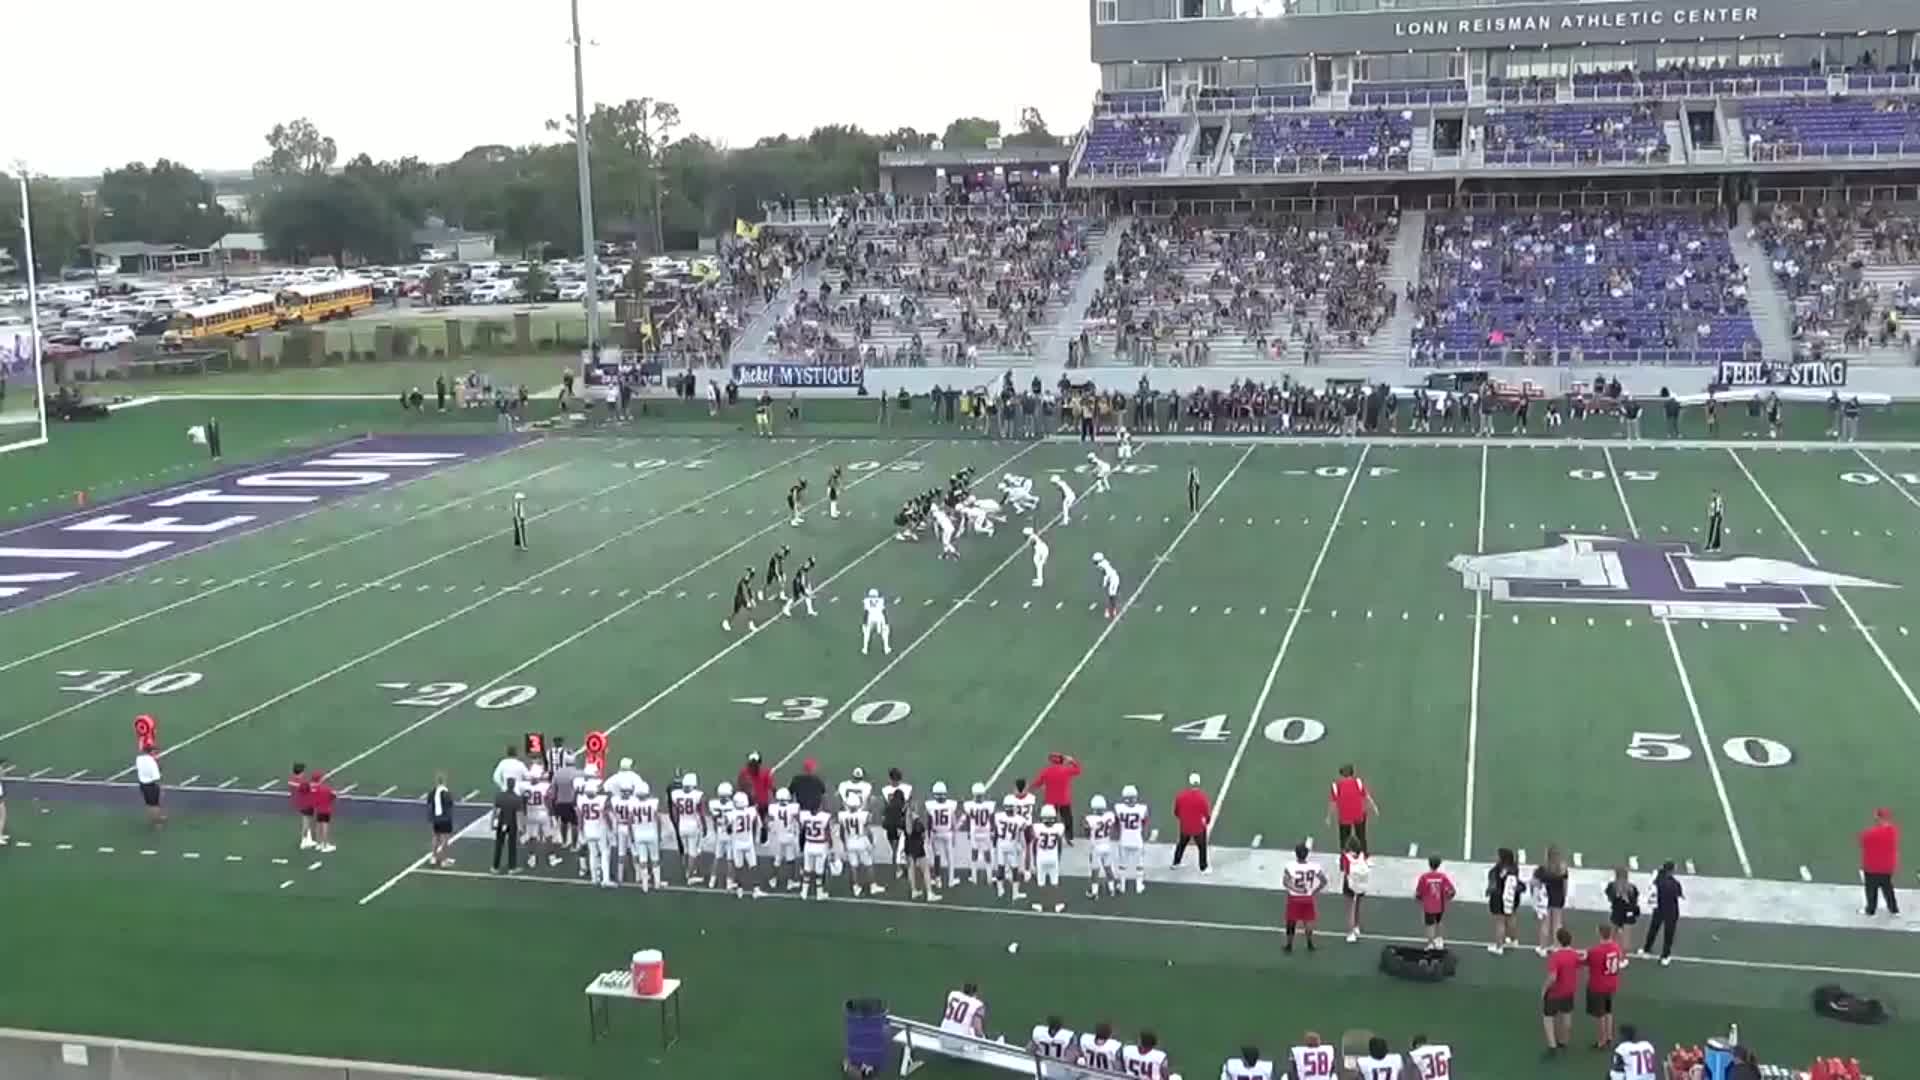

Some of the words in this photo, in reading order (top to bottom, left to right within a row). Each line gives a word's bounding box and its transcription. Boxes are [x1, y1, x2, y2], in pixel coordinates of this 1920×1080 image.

[1395, 22, 1448, 36] LONN
[1458, 17, 1550, 33] REISMAN
[1561, 11, 1664, 28] ATHLETIC
[1673, 7, 1759, 24] CENTER
[780, 365, 861, 384] MYSTIQUE
[1721, 361, 1766, 384] FEEL
[1789, 362, 1843, 384] STING
[0, 453, 466, 598] LETON
[528, 734, 541, 753] 3
[778, 809, 788, 828] 4
[933, 808, 949, 825] 16
[1119, 813, 1140, 830] 42
[1302, 1051, 1329, 1077] 58
[1420, 1052, 1448, 1079] 36
